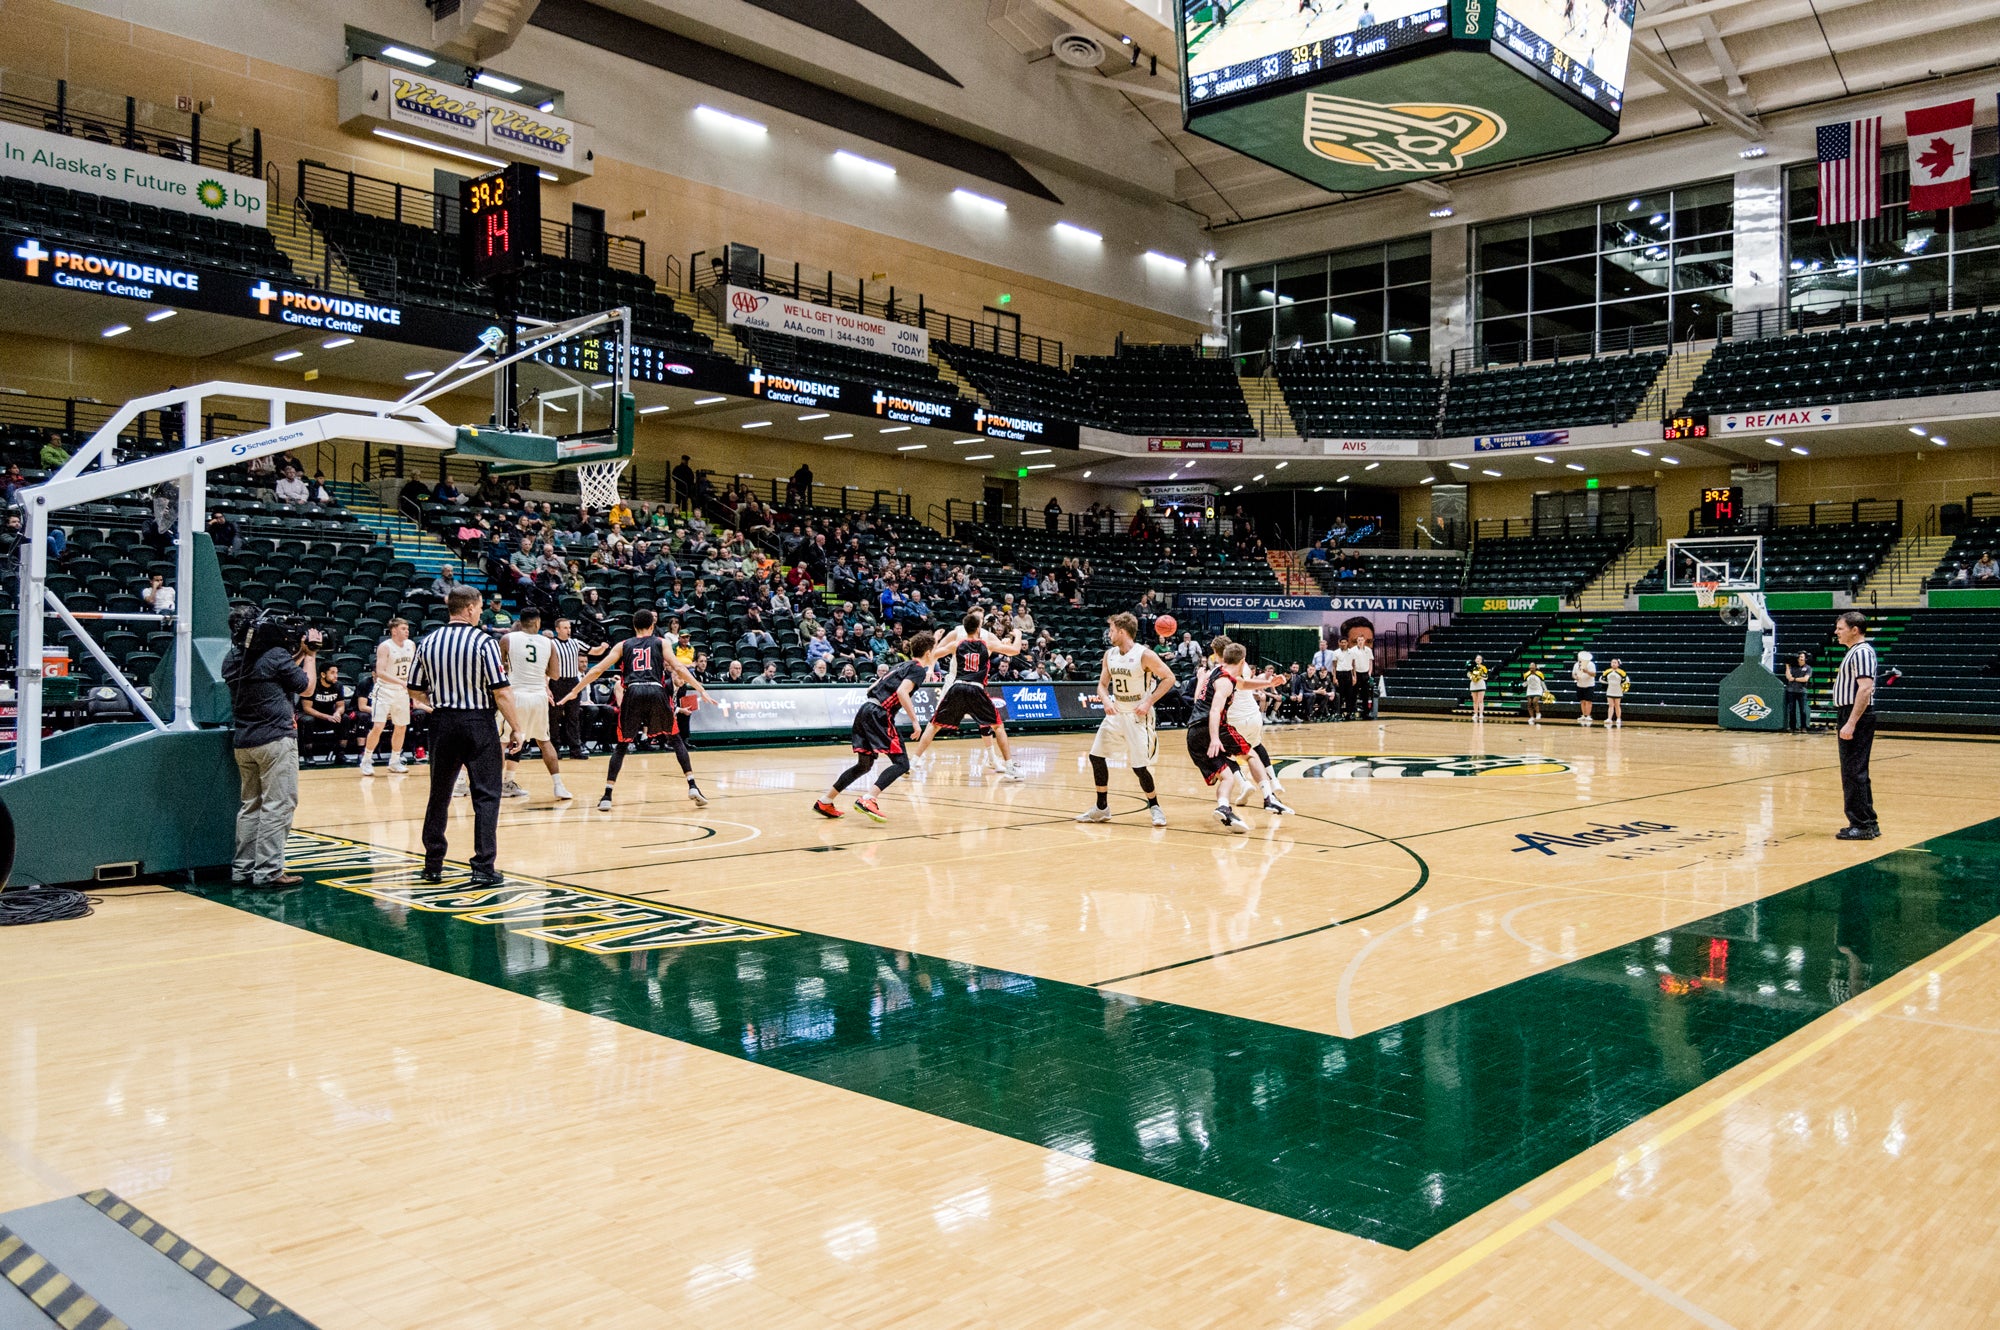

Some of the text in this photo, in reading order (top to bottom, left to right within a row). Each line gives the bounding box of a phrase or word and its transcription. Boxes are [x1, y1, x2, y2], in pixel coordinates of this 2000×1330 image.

[1410, 12, 1429, 25] Team
[1292, 42, 1322, 64] 39.4
[1334, 36, 1352, 57] 32
[1356, 38, 1386, 57] SAINTS
[1537, 41, 1548, 62] 33
[1262, 57, 1279, 77] 33
[1292, 60, 1321, 76] PER 1
[1552, 48, 1569, 72] 39.4
[1216, 74, 1258, 94] SEAWOLVES
[1563, 73, 1566, 82] 1
[1573, 66, 1582, 86] 32
[392, 78, 484, 120] Vito's
[402, 101, 472, 126] AUTO SALES
[490, 107, 571, 145] Vito's
[497, 127, 523, 140] AUTO
[529, 136, 561, 150] SALES
[4, 142, 187, 196] In Alaska's Future
[234, 189, 261, 214] bp
[471, 178, 504, 214] 39.2
[488, 210, 508, 256] 14
[54, 250, 199, 290] PROVIDENCE
[55, 272, 153, 299] Cancer Center
[282, 290, 401, 325] PROVIDENCE
[735, 292, 756, 313] AAA
[282, 310, 363, 333] Cancer Center
[745, 316, 770, 328] Alaska
[784, 304, 886, 336] WE'LL GET YOU HOME!
[784, 320, 874, 347] AAA.com 344-4310
[898, 330, 918, 343] JOIN
[574, 347, 579, 356] 7
[584, 349, 598, 359] PTS
[634, 358, 639, 366] 4
[630, 346, 639, 355] 15
[642, 349, 651, 357] 10
[658, 351, 664, 359] 4
[892, 342, 924, 358] TODAY!
[584, 361, 598, 370] FLS
[768, 374, 840, 398] PROVIDENCE
[768, 390, 817, 406] Cancer Center
[888, 396, 951, 418] PROVIDENCE
[888, 410, 931, 425] Cancer Center
[988, 414, 1043, 433] PROVIDENCE
[1746, 411, 1811, 428] RE/MAX
[247, 432, 304, 449] Schelde Sports
[988, 427, 1025, 440] Cancer Center
[1665, 430, 1676, 438] 33
[1694, 427, 1706, 436] 32
[1342, 441, 1366, 450] AVIS
[1705, 490, 1730, 502] 39.2
[1716, 502, 1732, 519] 14
[1187, 598, 1305, 608] THE VOICE OF ALASKA
[1344, 599, 1444, 610] KTVA 11 NEWS
[1483, 598, 1539, 611] SUBWAY
[526, 645, 537, 662] 3
[633, 648, 652, 671] 21
[964, 653, 980, 673] 10
[44, 664, 58, 676] G
[396, 666, 407, 676] 13
[1013, 687, 1048, 702] Alaska
[1116, 679, 1129, 692] 21
[733, 700, 796, 710] PROVIDENCE
[914, 690, 929, 703] 33
[1511, 820, 1679, 856] Alaska
